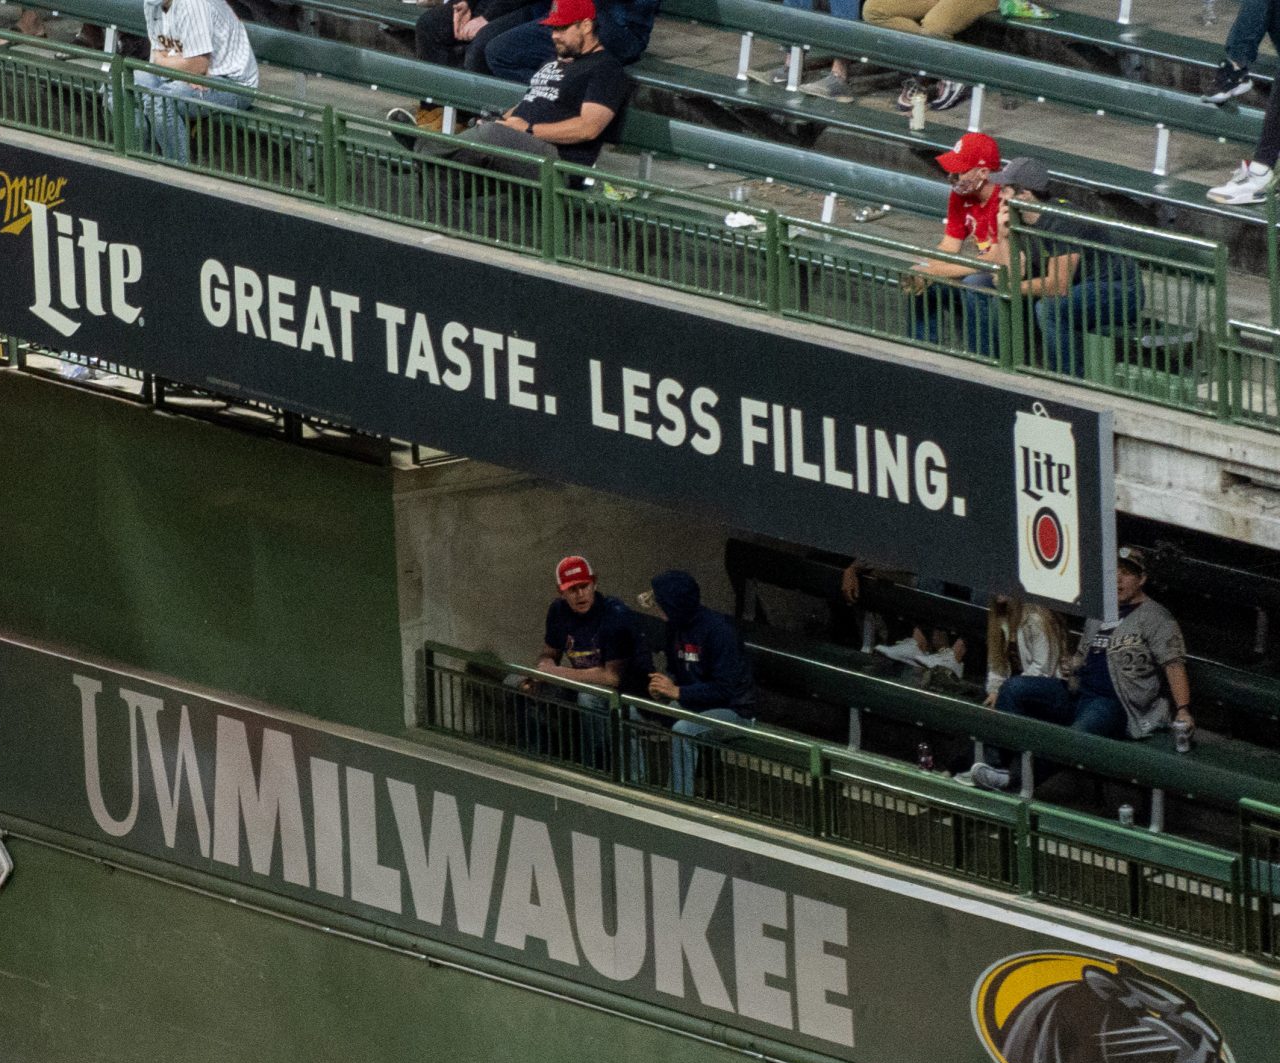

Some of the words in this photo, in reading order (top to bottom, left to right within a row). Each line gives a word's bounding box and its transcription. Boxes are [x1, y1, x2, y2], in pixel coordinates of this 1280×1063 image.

[24, 199, 142, 337] Lite
[200, 259, 360, 362] GREAT
[376, 302, 557, 416] TASTE.
[589, 360, 721, 456] LESS
[740, 398, 966, 517] FILLING.
[1020, 446, 1072, 501] Lite
[73, 674, 855, 1047] UWMILWAUKEE
